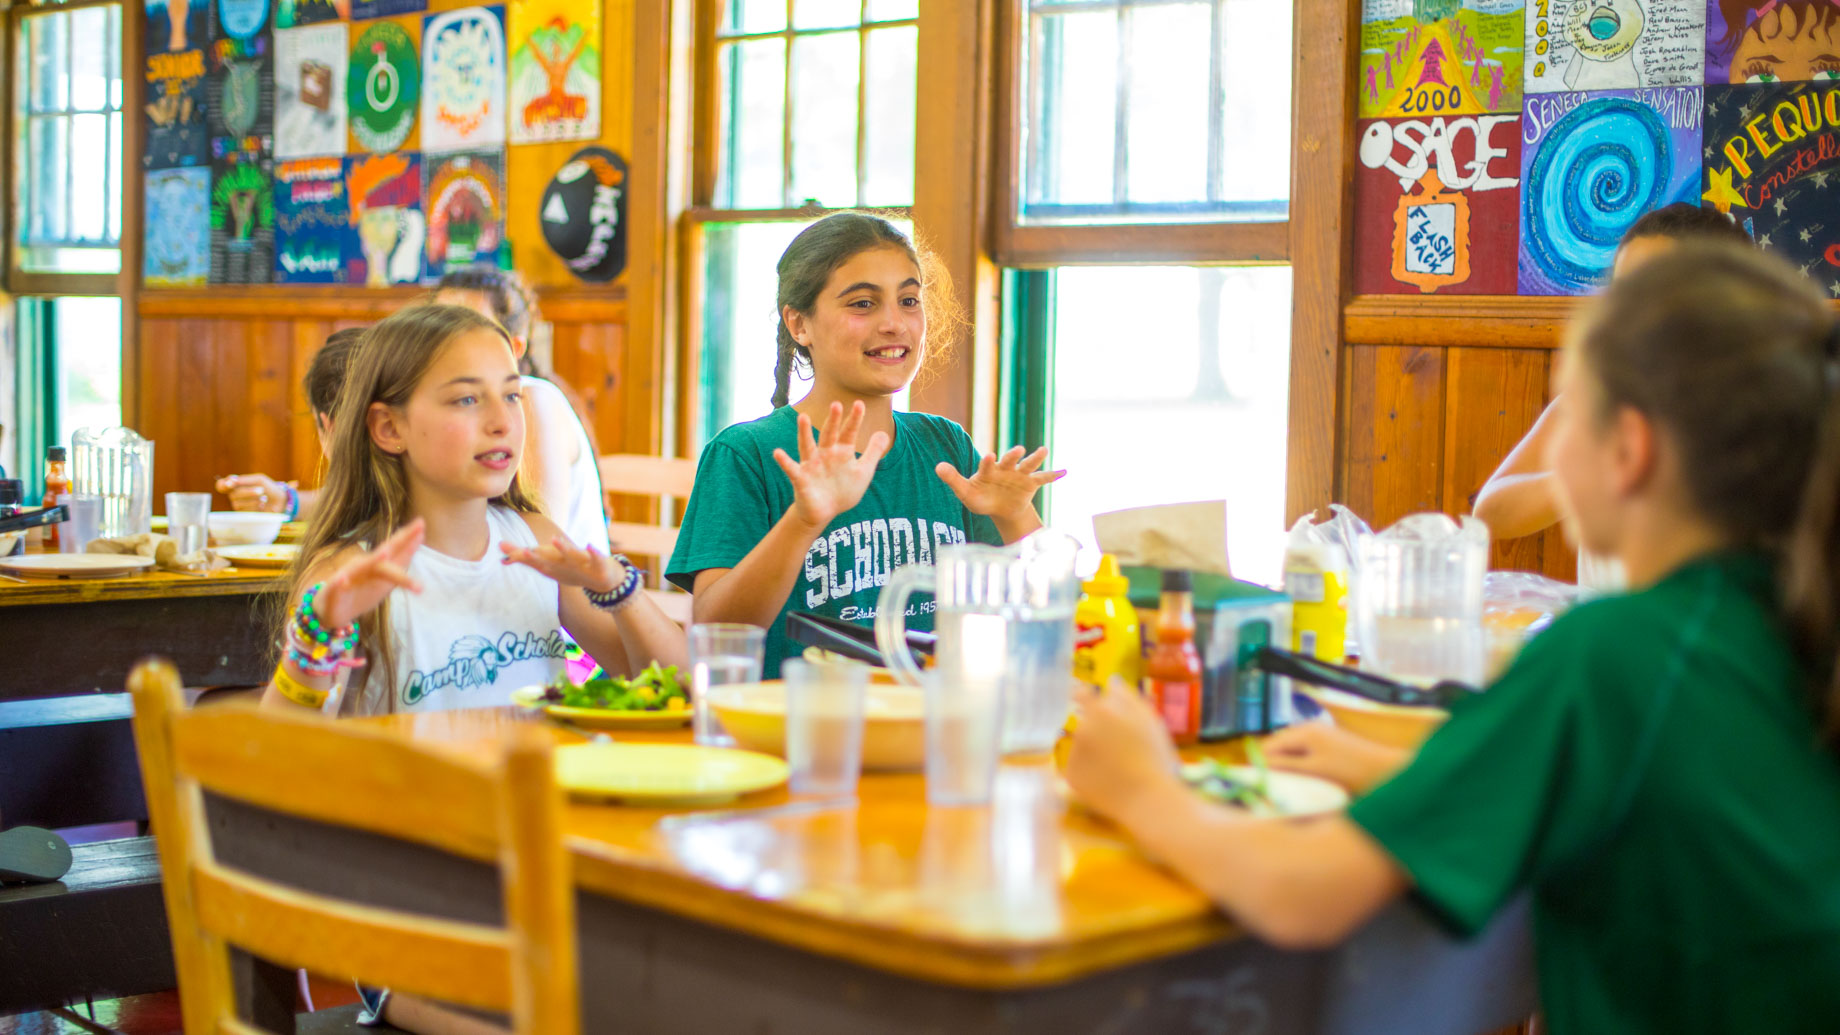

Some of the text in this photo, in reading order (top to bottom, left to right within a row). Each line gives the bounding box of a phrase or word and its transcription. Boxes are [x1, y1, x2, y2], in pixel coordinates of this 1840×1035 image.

[1400, 85, 1461, 112] 2000
[1523, 91, 1589, 144] SENECA
[1633, 87, 1705, 130] SENSATION
[1359, 116, 1520, 193] OSAGE
[1408, 206, 1455, 263] FLASH
[1409, 231, 1442, 272] BACK
[920, 600, 939, 615] 195
[402, 668, 470, 706] Camp
